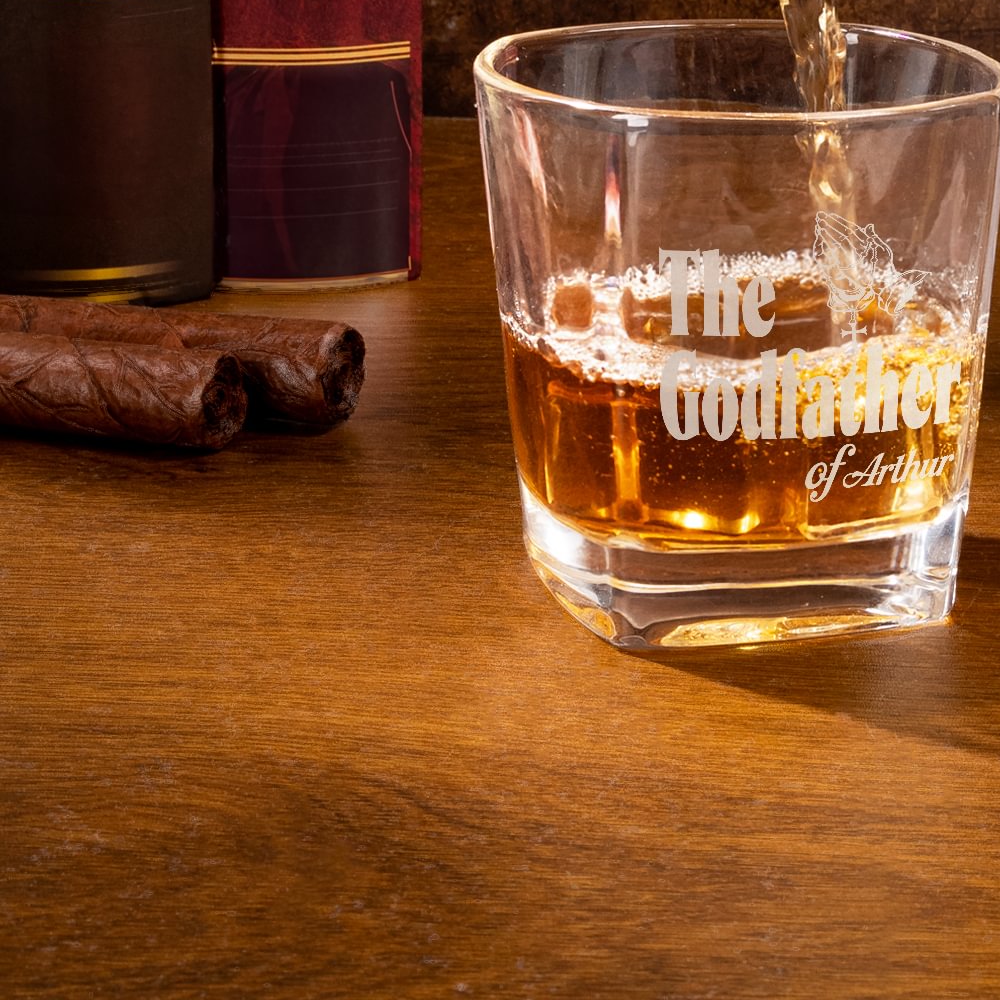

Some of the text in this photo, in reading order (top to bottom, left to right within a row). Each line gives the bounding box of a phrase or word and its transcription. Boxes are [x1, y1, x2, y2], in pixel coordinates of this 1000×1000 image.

[658, 247, 776, 338] The
[659, 344, 961, 442] Godfather
[804, 443, 955, 502] of Arthur
